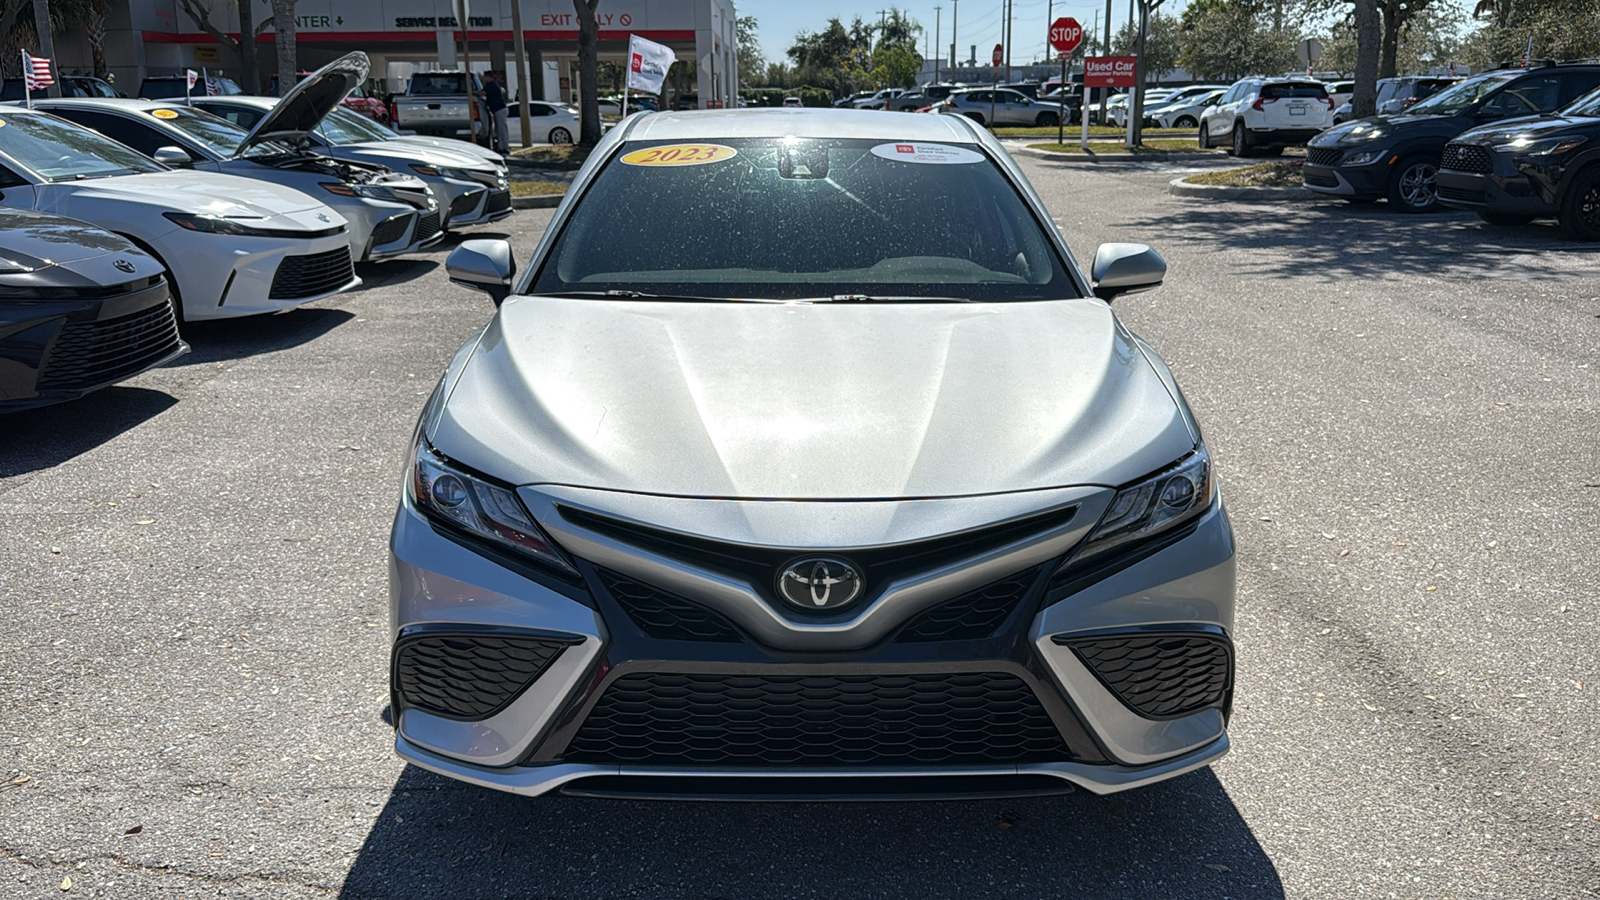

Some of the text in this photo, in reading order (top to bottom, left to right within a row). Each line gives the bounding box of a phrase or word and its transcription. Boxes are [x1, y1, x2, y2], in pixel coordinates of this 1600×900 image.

[294, 16, 330, 28] NTER
[396, 17, 492, 28] SERVICE RECTION
[541, 14, 614, 26] EXIT LY
[1051, 27, 1080, 42] STOP
[1086, 61, 1134, 71] Used Car
[639, 147, 719, 163] 2023
